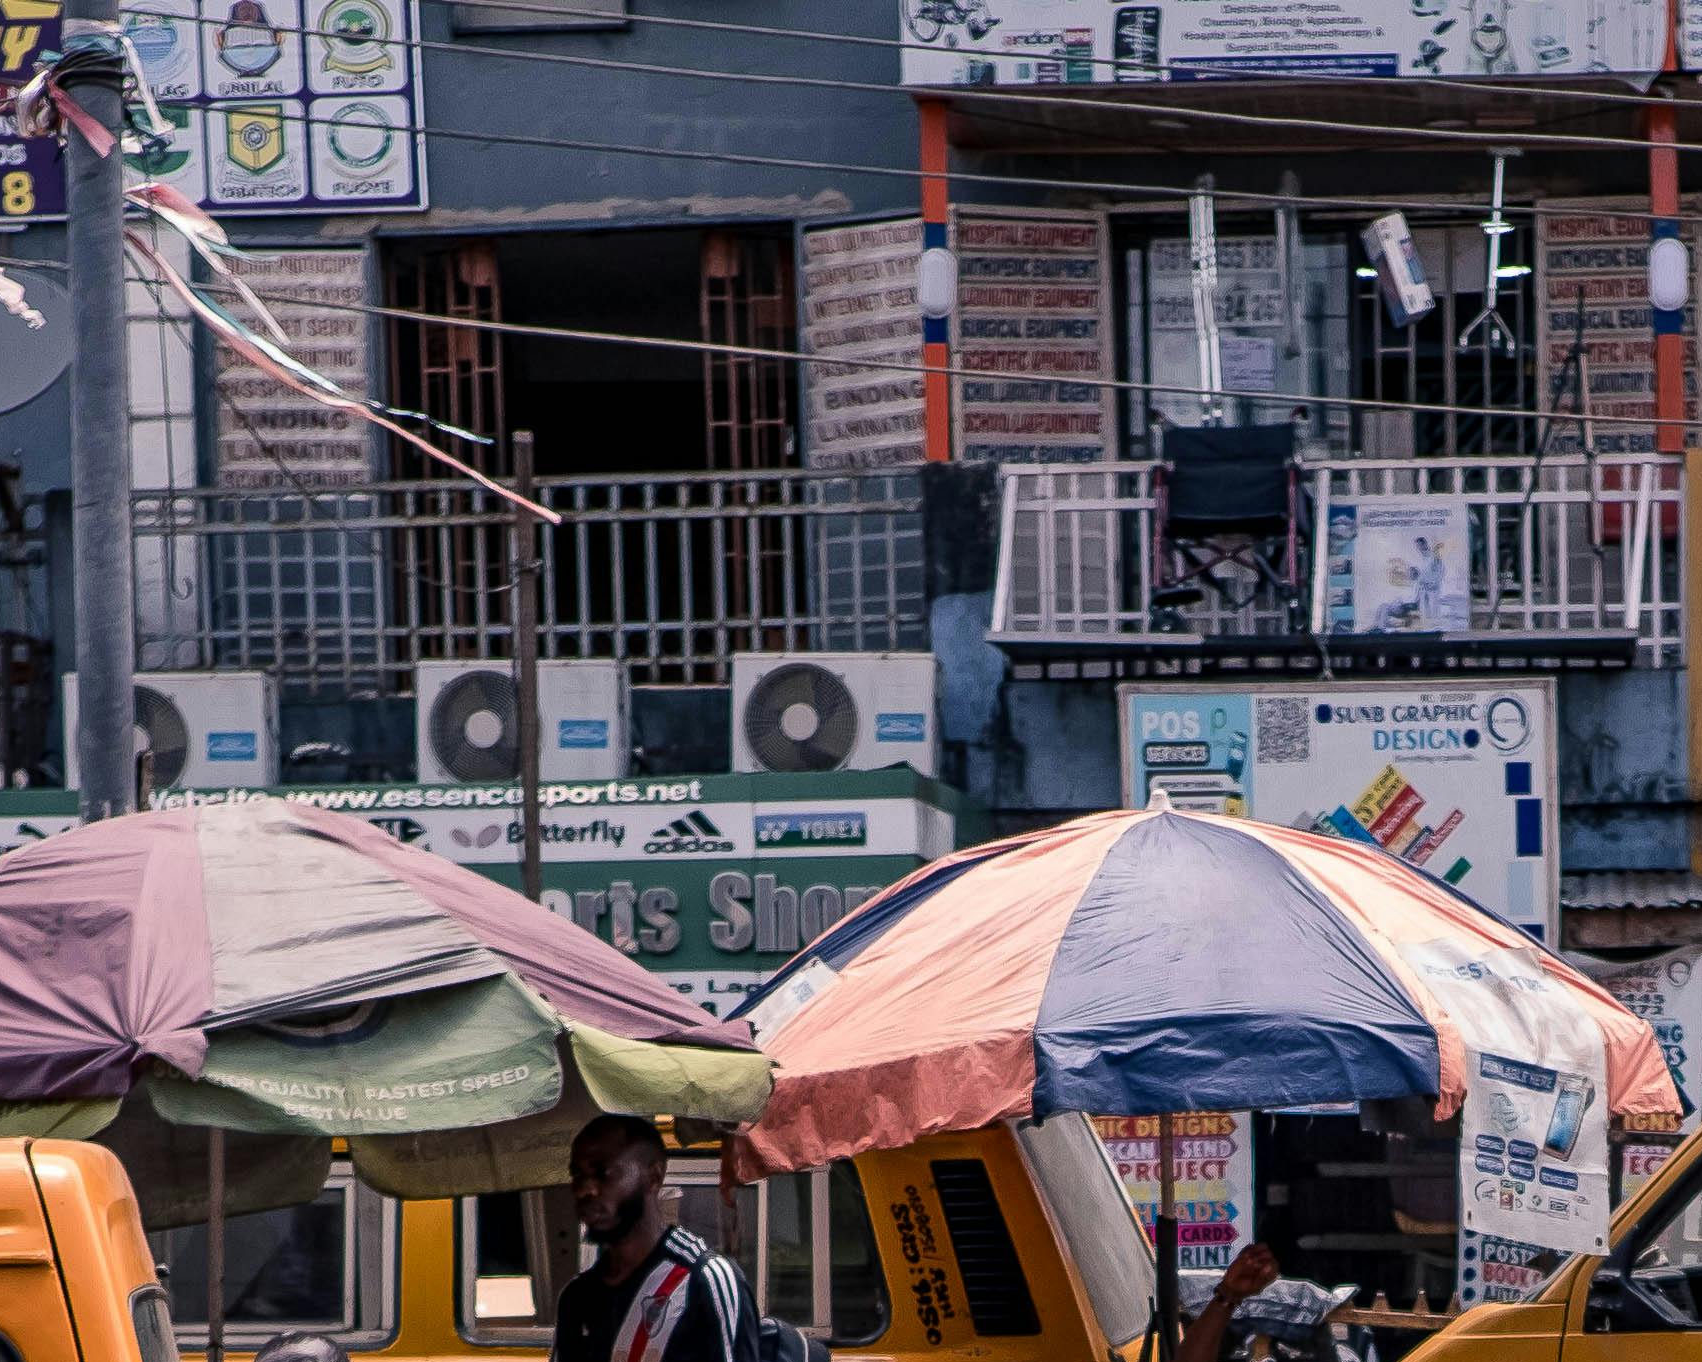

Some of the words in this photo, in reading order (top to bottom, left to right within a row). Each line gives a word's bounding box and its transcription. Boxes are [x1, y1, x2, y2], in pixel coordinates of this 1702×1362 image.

[1332, 705, 1385, 724] SUNB
[1390, 703, 1481, 723] GRAPHIC
[1141, 710, 1200, 740] POS
[1373, 728, 1461, 752] DESIGN
[1145, 745, 1208, 763] SERVICES
[644, 839, 736, 855] adidas
[259, 1079, 347, 1102] QUALITY
[364, 1079, 458, 1102] FASTEST
[460, 1064, 531, 1092] SPEED
[339, 1104, 410, 1121] VALUE
[1181, 1141, 1234, 1159] SEND
[1180, 1227, 1234, 1243] CARDS
[1180, 1246, 1231, 1268] RINT
